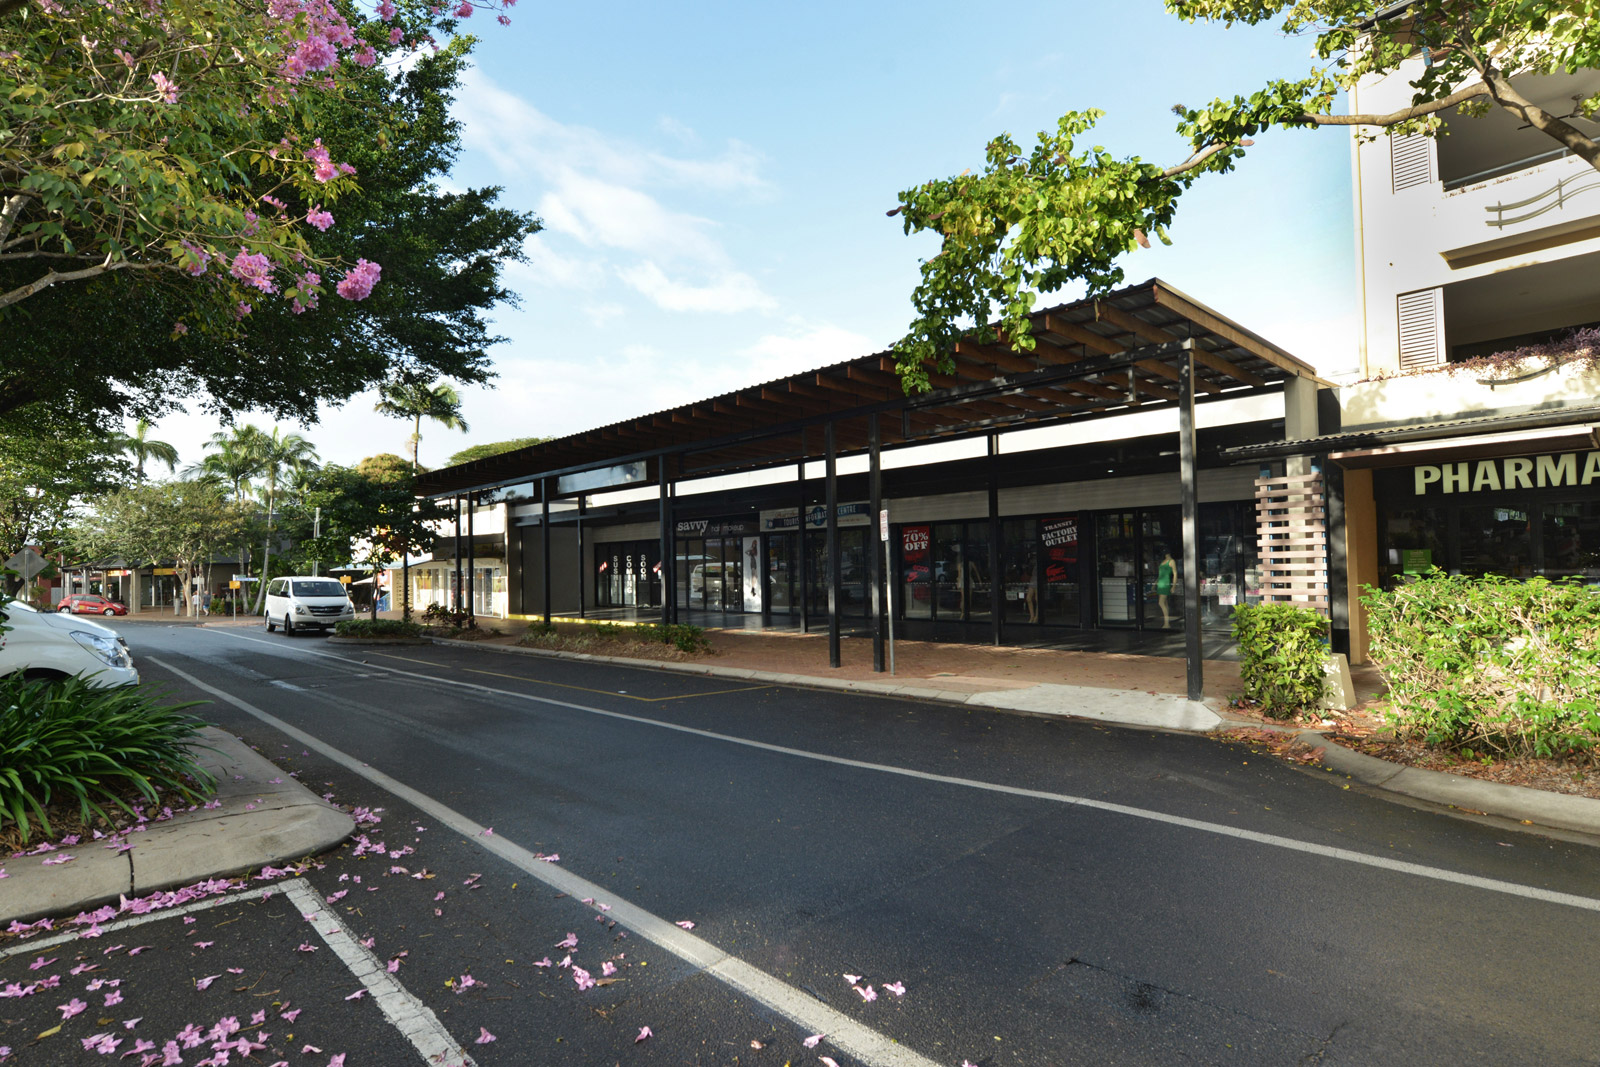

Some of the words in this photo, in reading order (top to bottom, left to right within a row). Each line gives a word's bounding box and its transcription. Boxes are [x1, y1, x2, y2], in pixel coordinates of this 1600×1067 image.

[837, 504, 857, 516] CENTRE
[677, 520, 709, 537] savvy
[1044, 520, 1073, 531] TRANSIT
[903, 532, 929, 543] 70%
[1041, 526, 1078, 541] FACTORY
[904, 541, 928, 551] OFF
[1045, 533, 1078, 547] OUTLET
